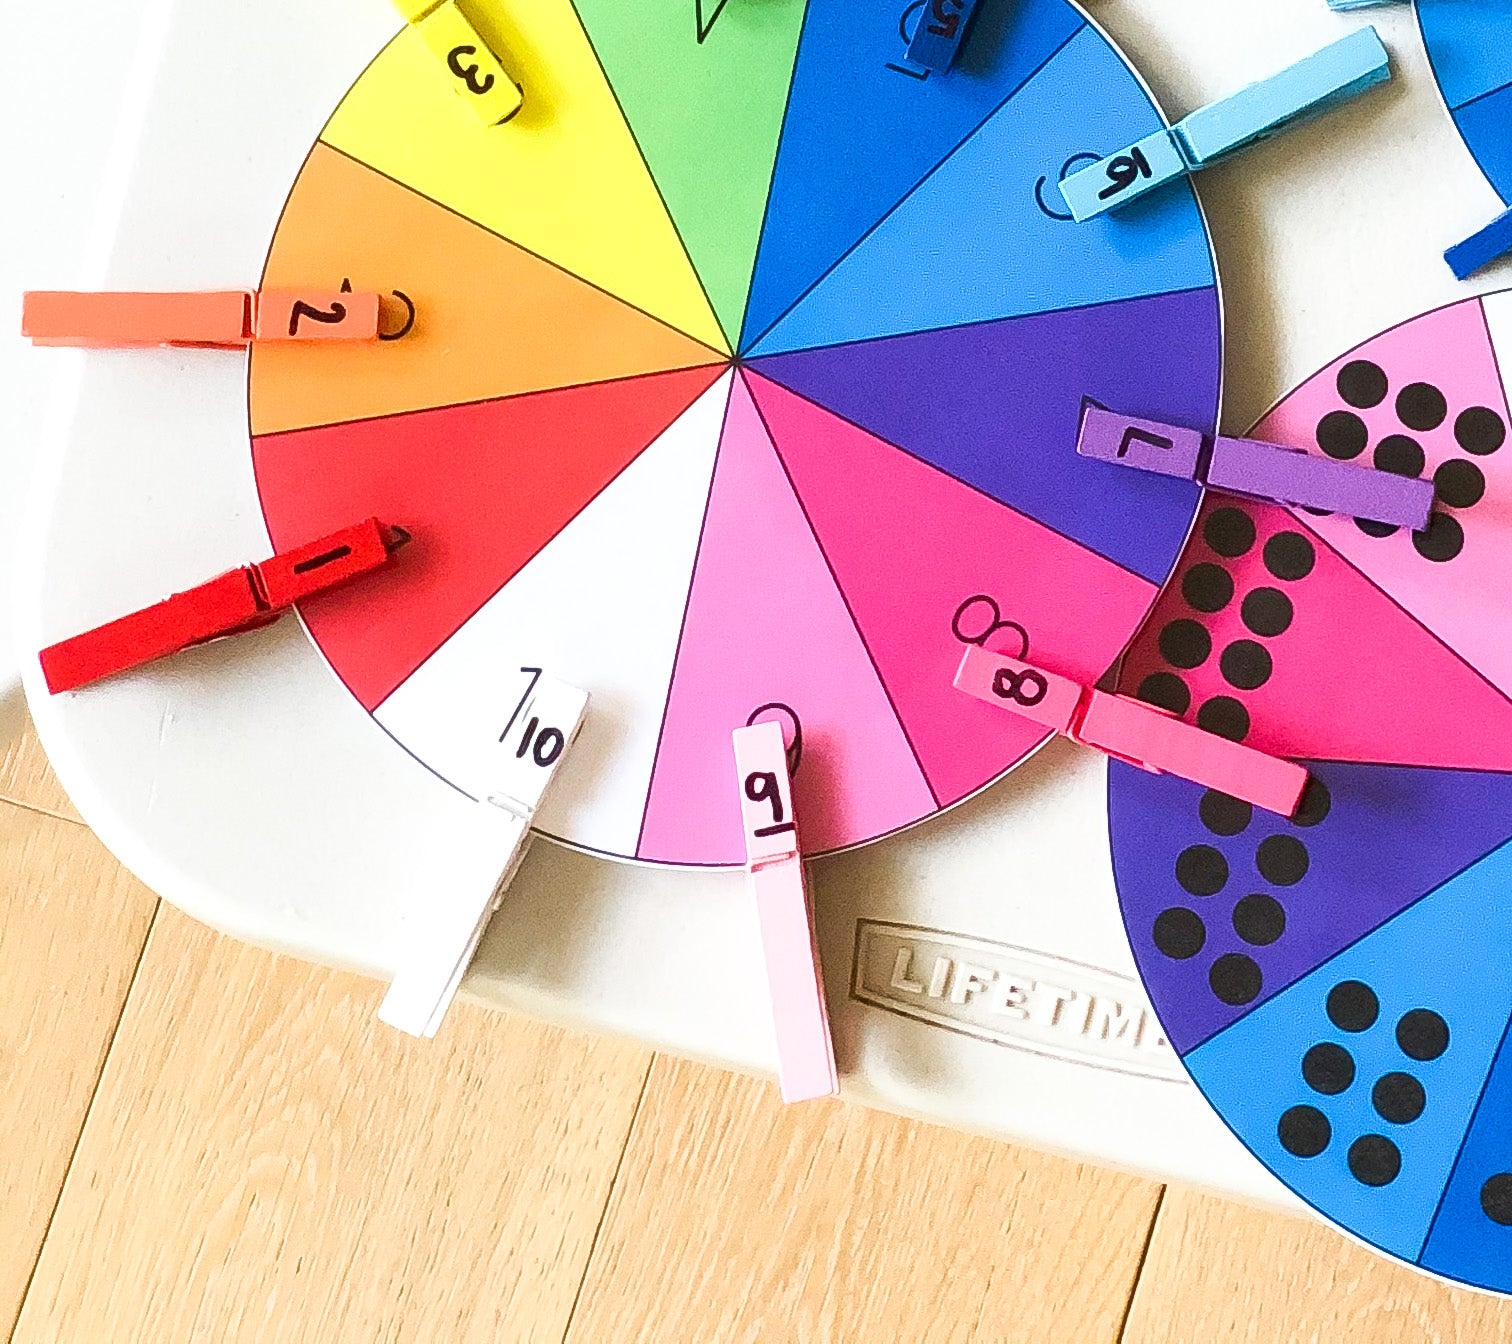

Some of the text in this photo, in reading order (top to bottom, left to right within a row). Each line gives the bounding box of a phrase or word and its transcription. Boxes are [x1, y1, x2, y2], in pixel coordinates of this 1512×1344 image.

[446, 45, 495, 95] 3
[1098, 148, 1146, 201] 6
[288, 301, 347, 337] 2
[1116, 426, 1174, 459] 7
[293, 544, 353, 575] 1
[991, 667, 1049, 707] 8
[515, 715, 565, 767] 10
[744, 771, 788, 827] 9
[890, 945, 1167, 1048] LIFETIM
